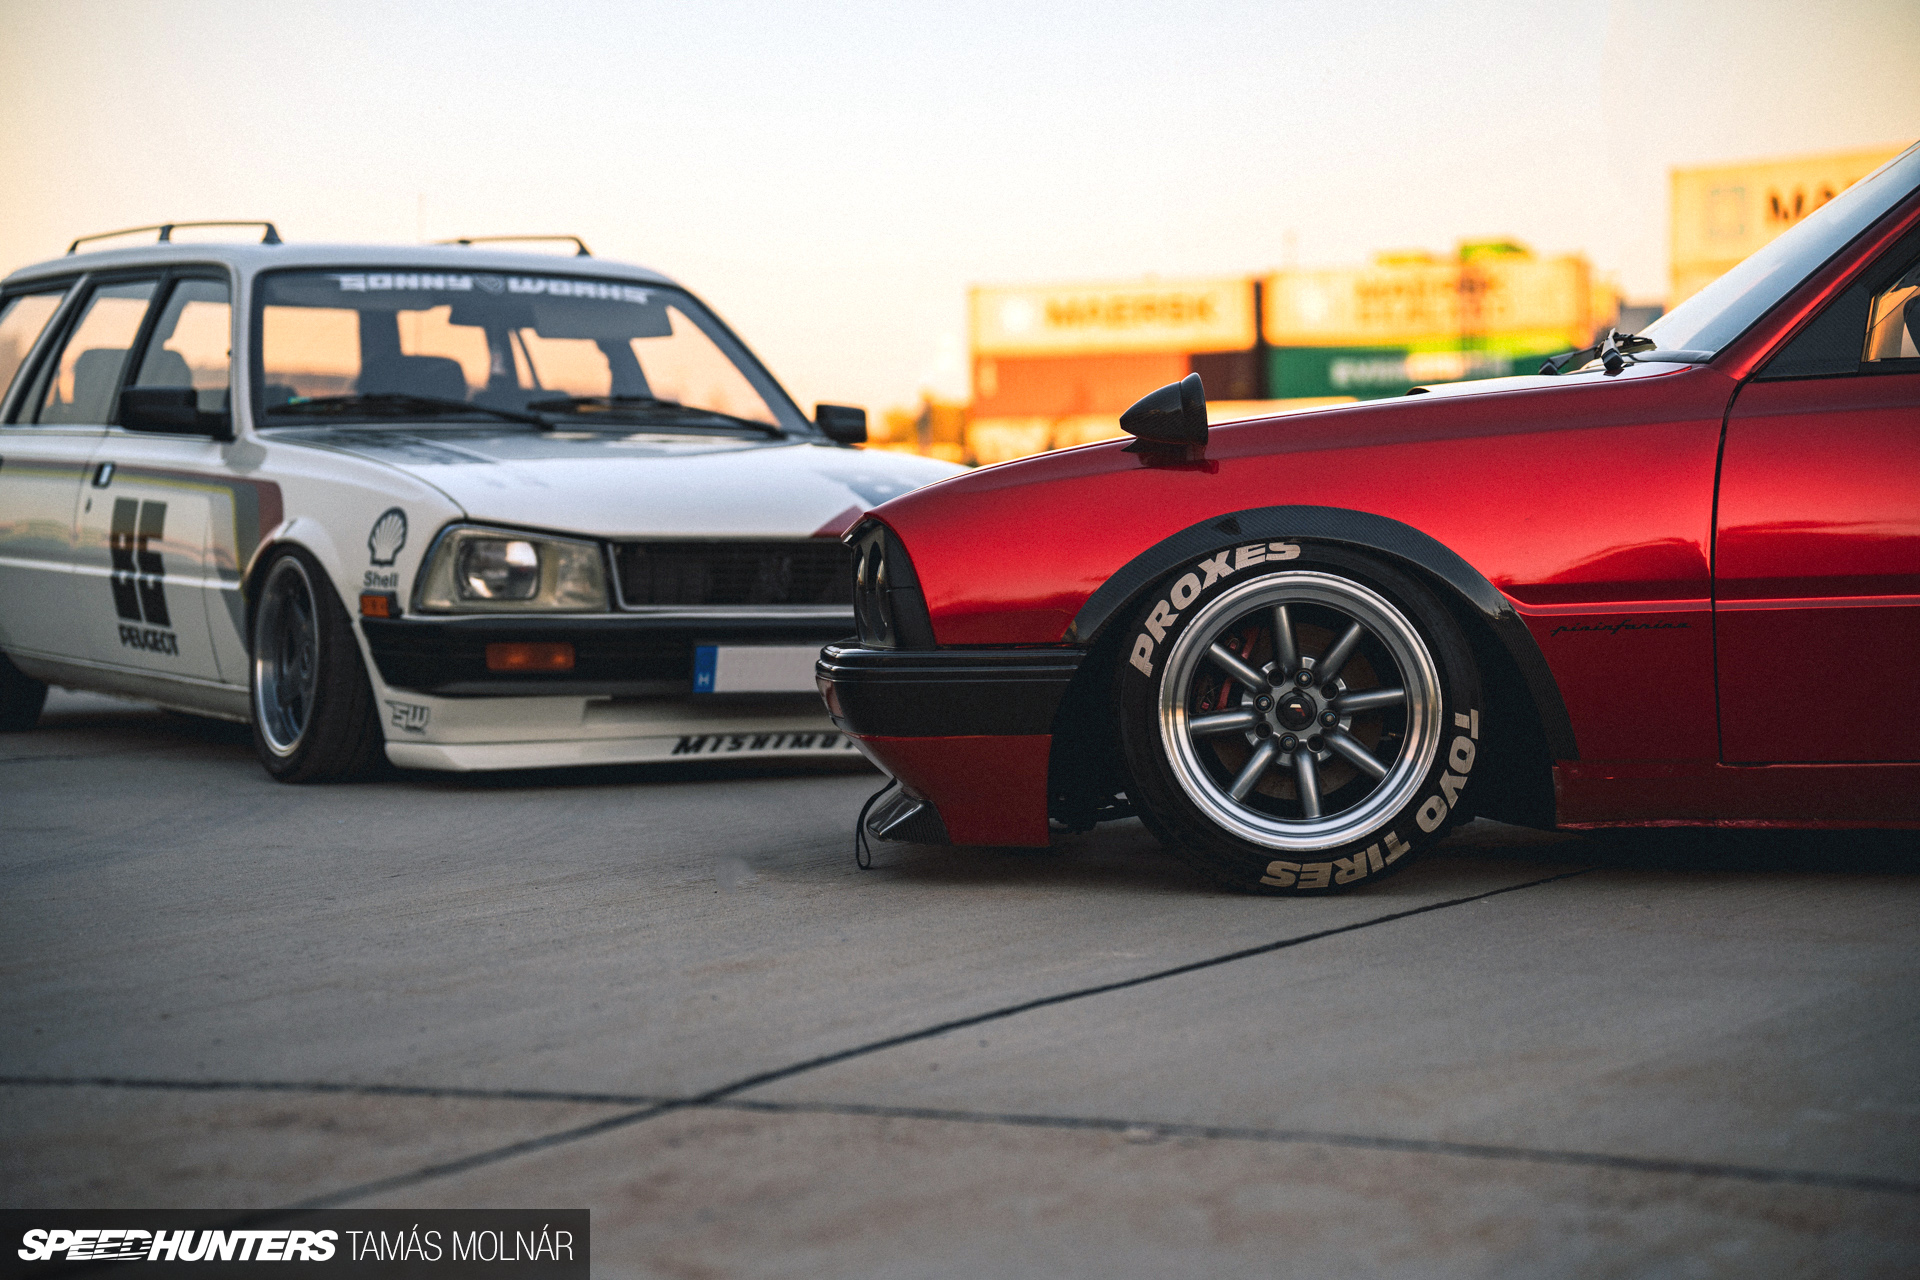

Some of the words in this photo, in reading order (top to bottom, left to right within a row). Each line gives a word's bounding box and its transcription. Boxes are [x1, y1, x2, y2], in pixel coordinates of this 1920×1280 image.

[363, 570, 398, 588] Shell
[1129, 541, 1301, 678] PROXES
[1551, 619, 1692, 637] pininfarina
[118, 622, 180, 657] PEUGEOT
[1415, 708, 1479, 833] TOYO
[1260, 830, 1411, 889] TIRES
